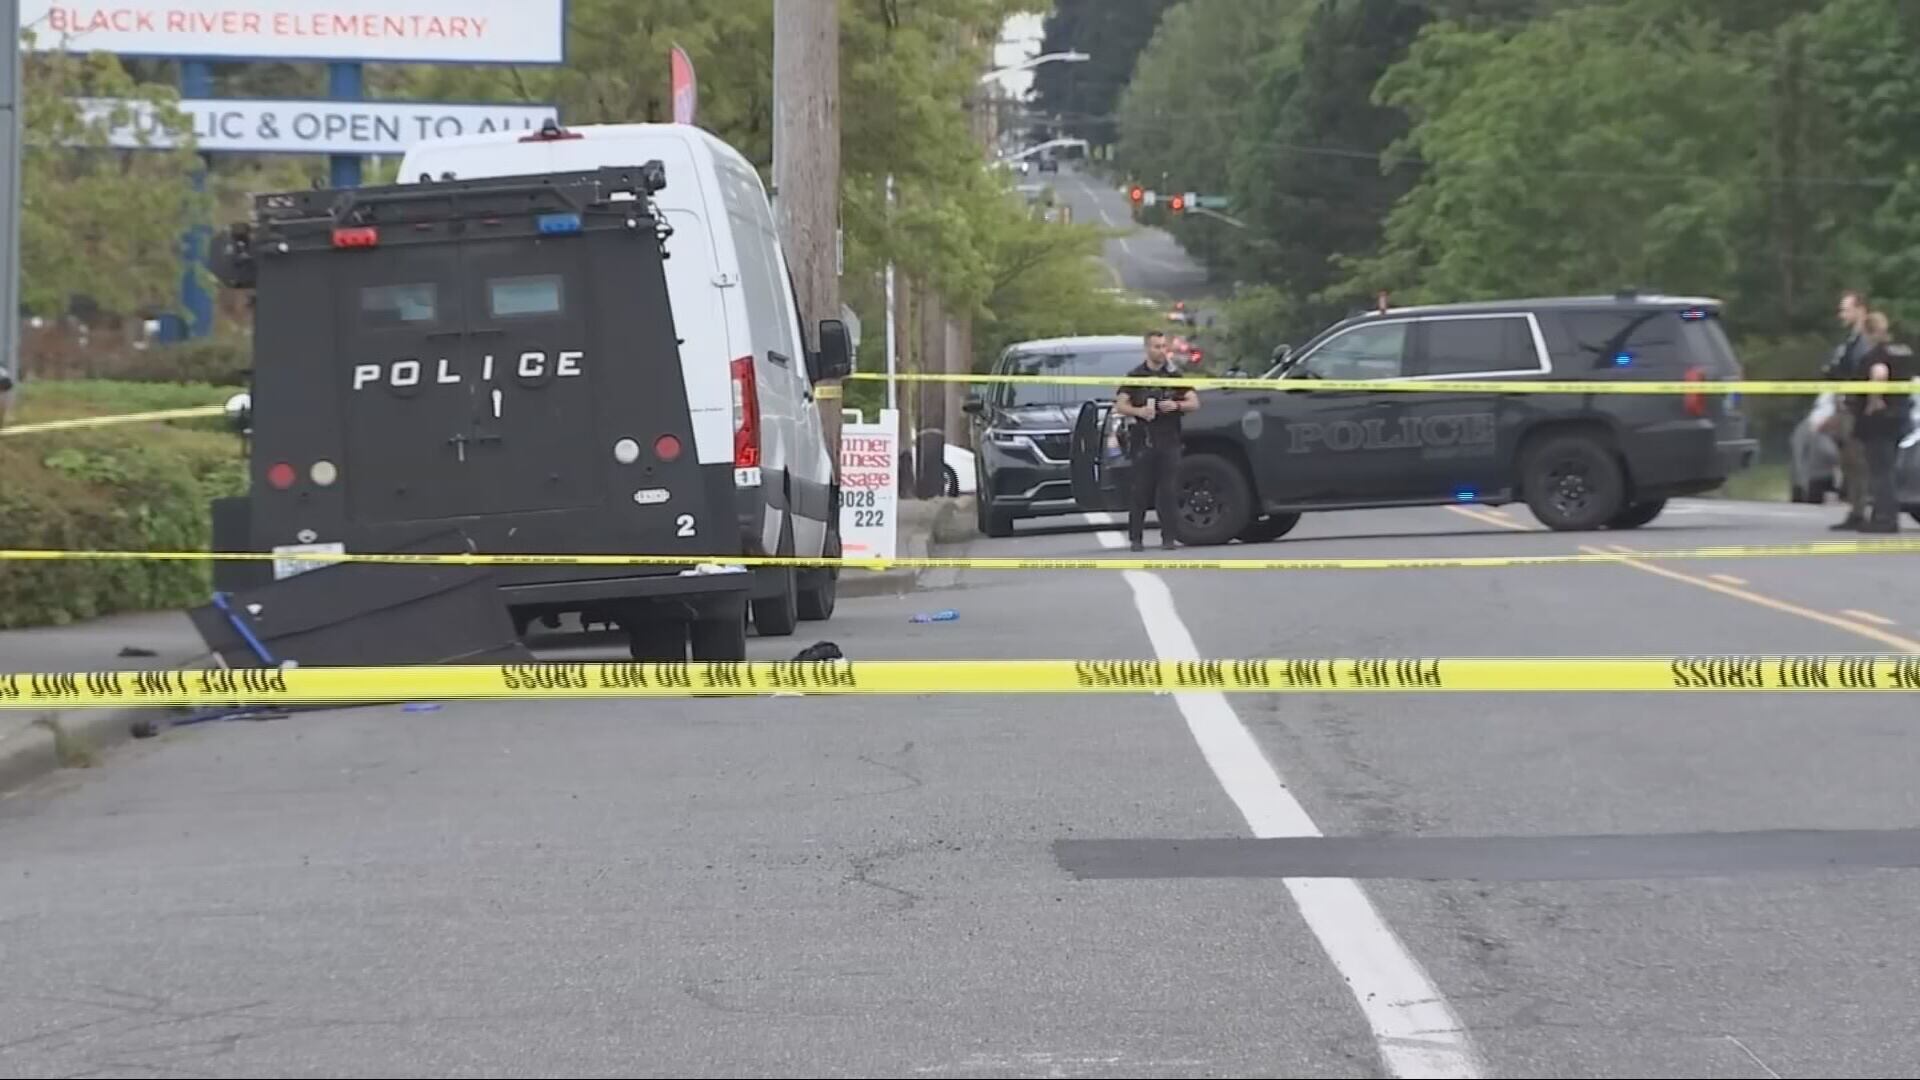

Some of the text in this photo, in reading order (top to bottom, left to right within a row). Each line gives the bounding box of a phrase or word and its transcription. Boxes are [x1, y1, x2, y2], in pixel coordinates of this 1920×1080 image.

[49, 7, 489, 38] BLACK RIVER ELEMENTARY
[256, 111, 280, 140] &
[292, 112, 400, 142] OPEN
[413, 115, 463, 140] TO
[353, 351, 584, 390] POLICE
[1284, 412, 1495, 454] POLICE
[676, 513, 697, 537] 2
[854, 510, 885, 528] 222
